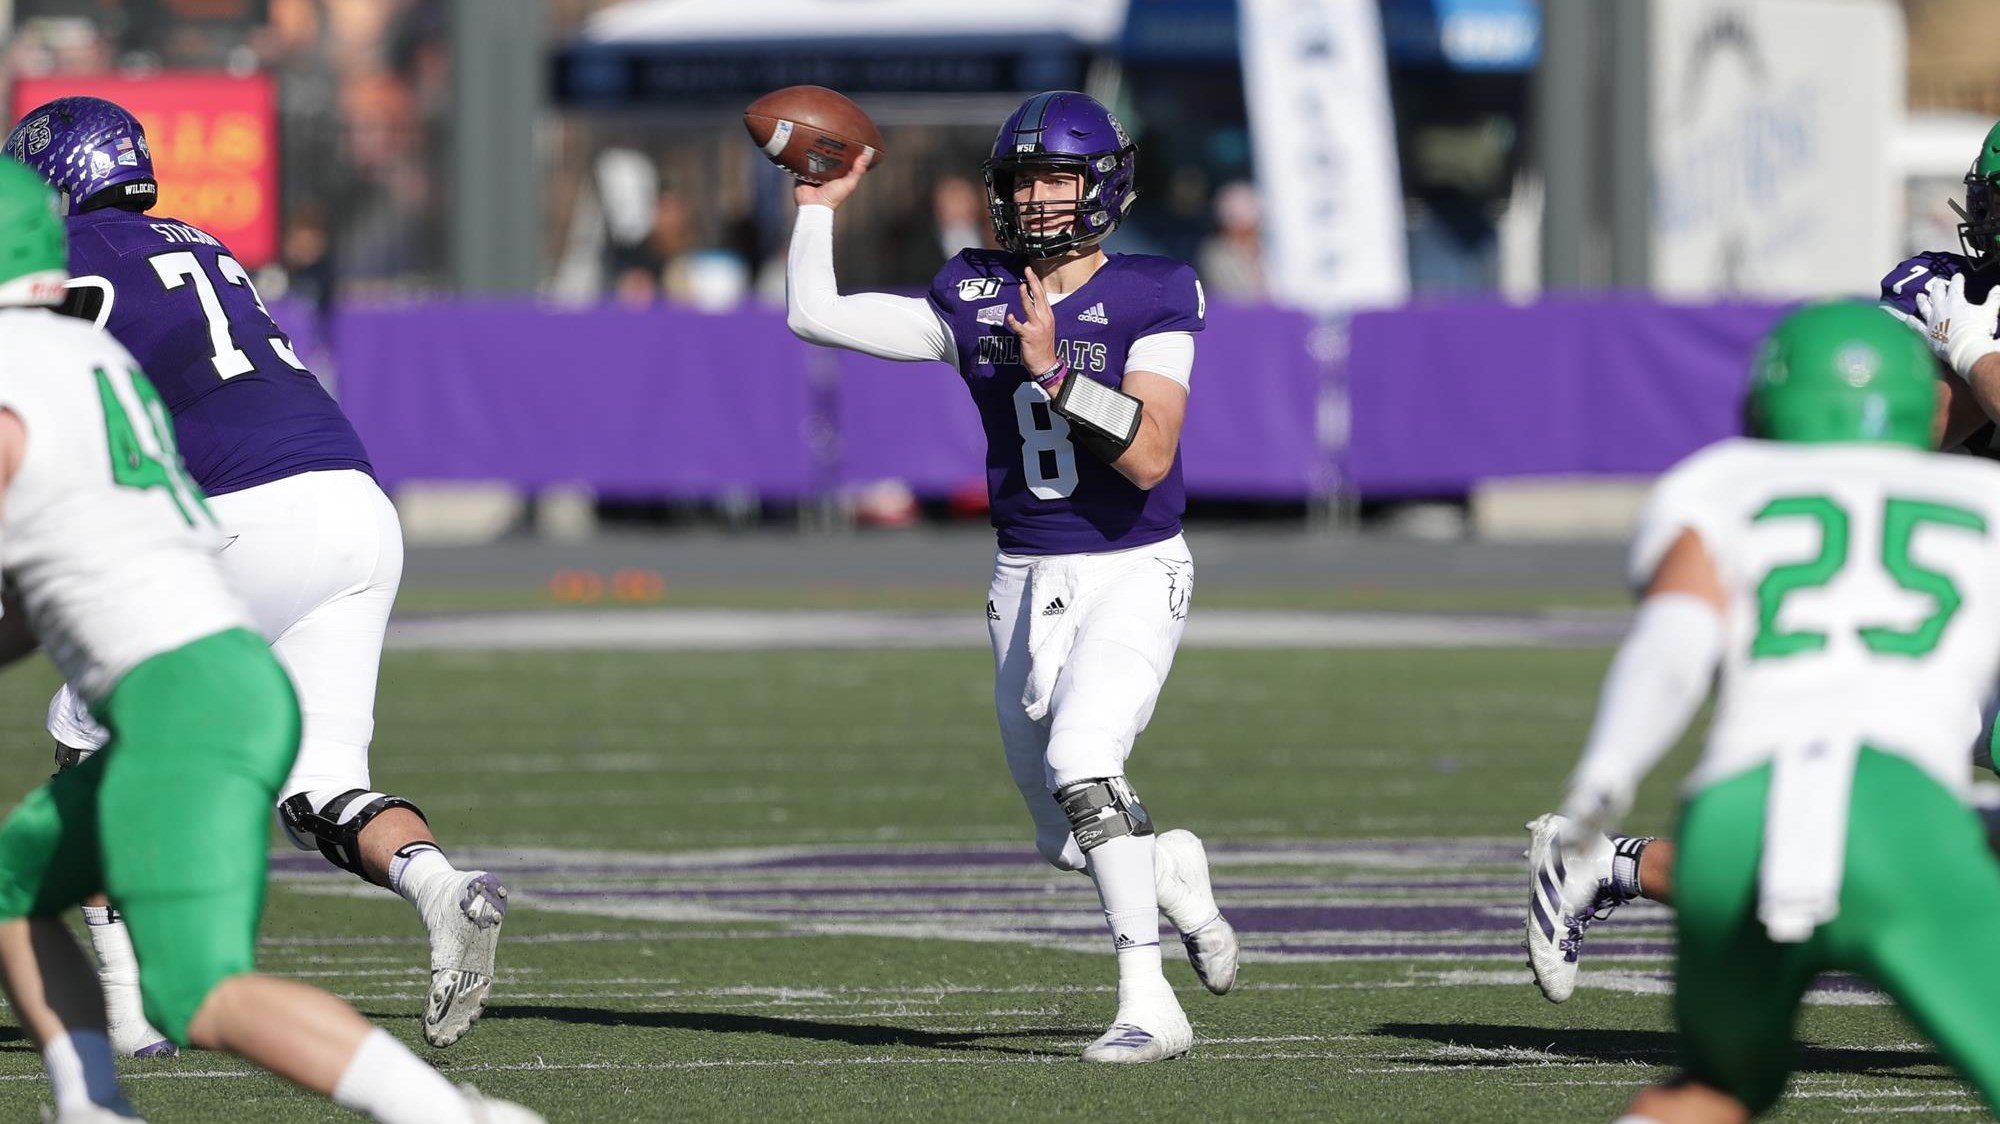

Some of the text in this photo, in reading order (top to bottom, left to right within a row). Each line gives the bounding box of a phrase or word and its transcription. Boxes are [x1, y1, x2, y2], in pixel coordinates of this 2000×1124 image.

[1016, 143, 1036, 153] WSU
[124, 183, 155, 196] WILDCATS
[960, 280, 1001, 300] 150
[148, 251, 309, 381] 73
[1077, 313, 1109, 325] adidas
[977, 335, 1107, 373] WILATS
[1012, 381, 1080, 500] 8
[1749, 496, 1988, 661] 25
[1042, 607, 1066, 617] adida
